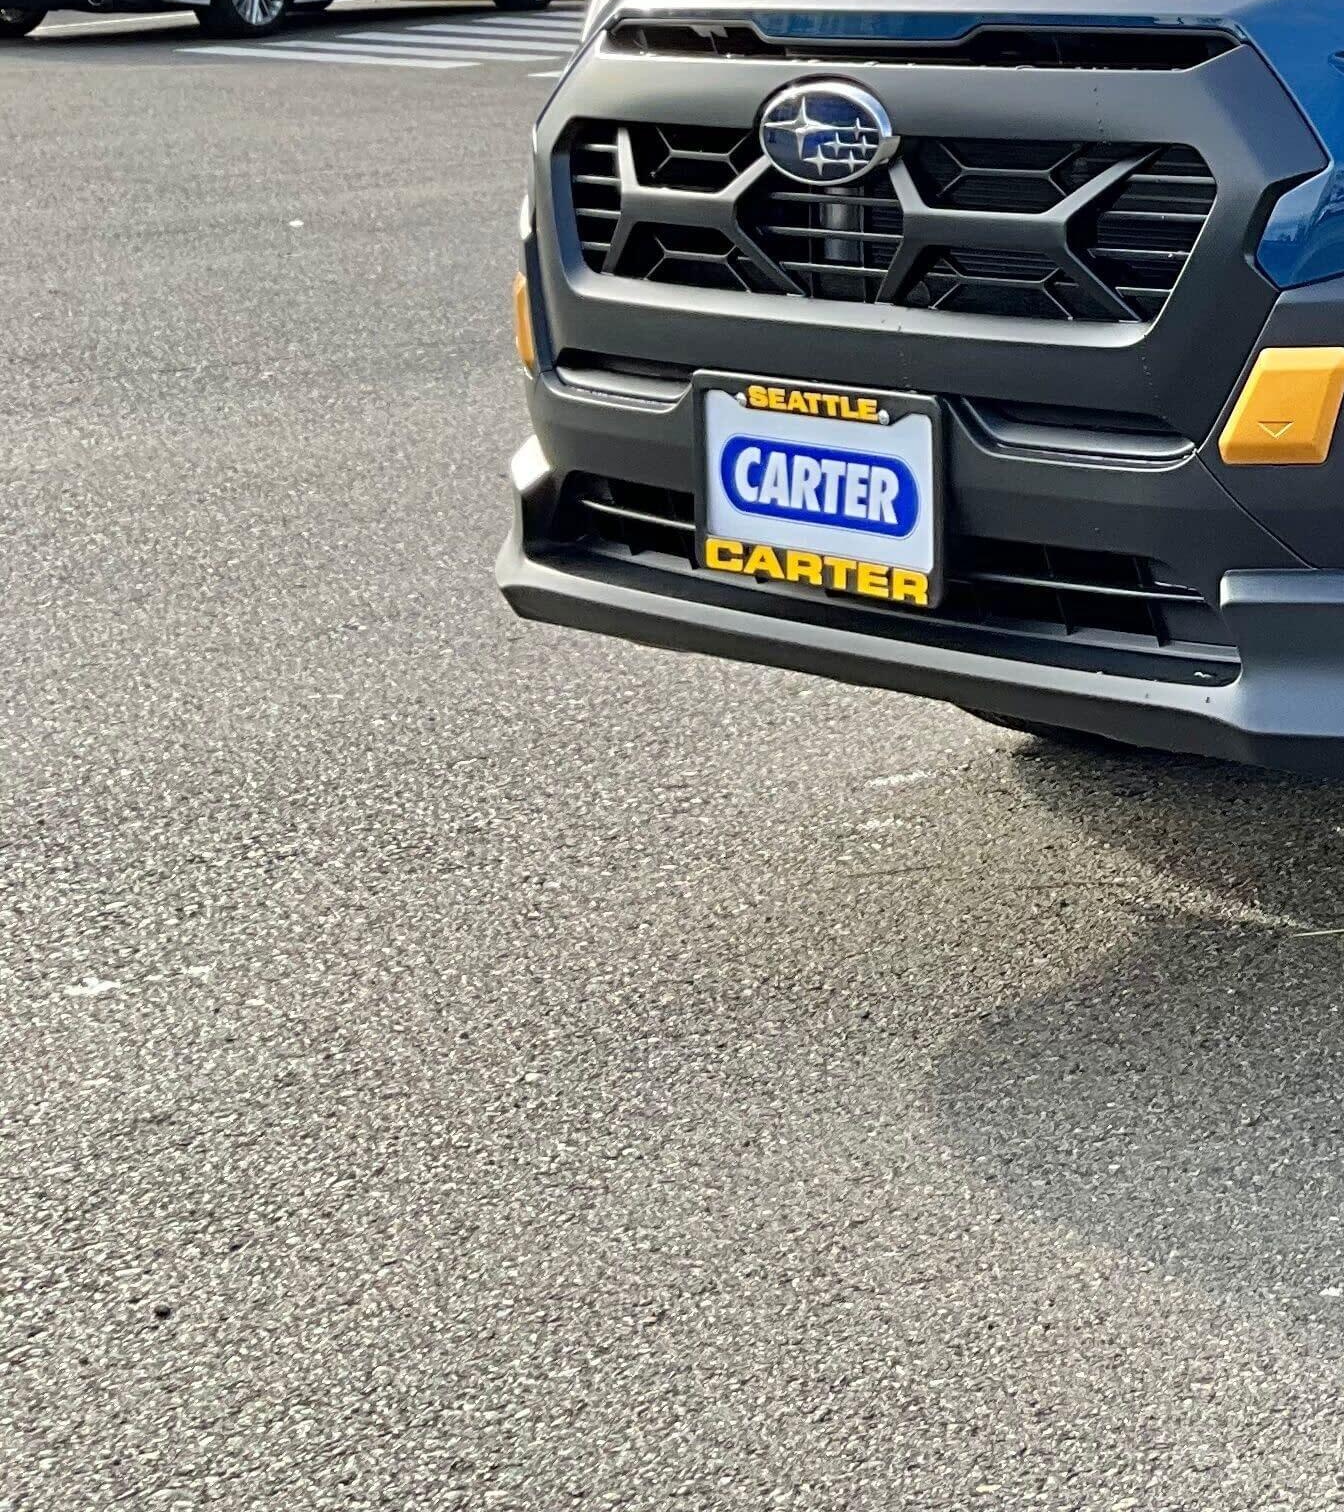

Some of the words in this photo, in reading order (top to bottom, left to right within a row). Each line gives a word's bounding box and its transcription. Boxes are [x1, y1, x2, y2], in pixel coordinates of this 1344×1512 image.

[748, 384, 879, 422] SEATTLE
[734, 446, 899, 525] CARTER
[705, 538, 929, 606] CARTER
